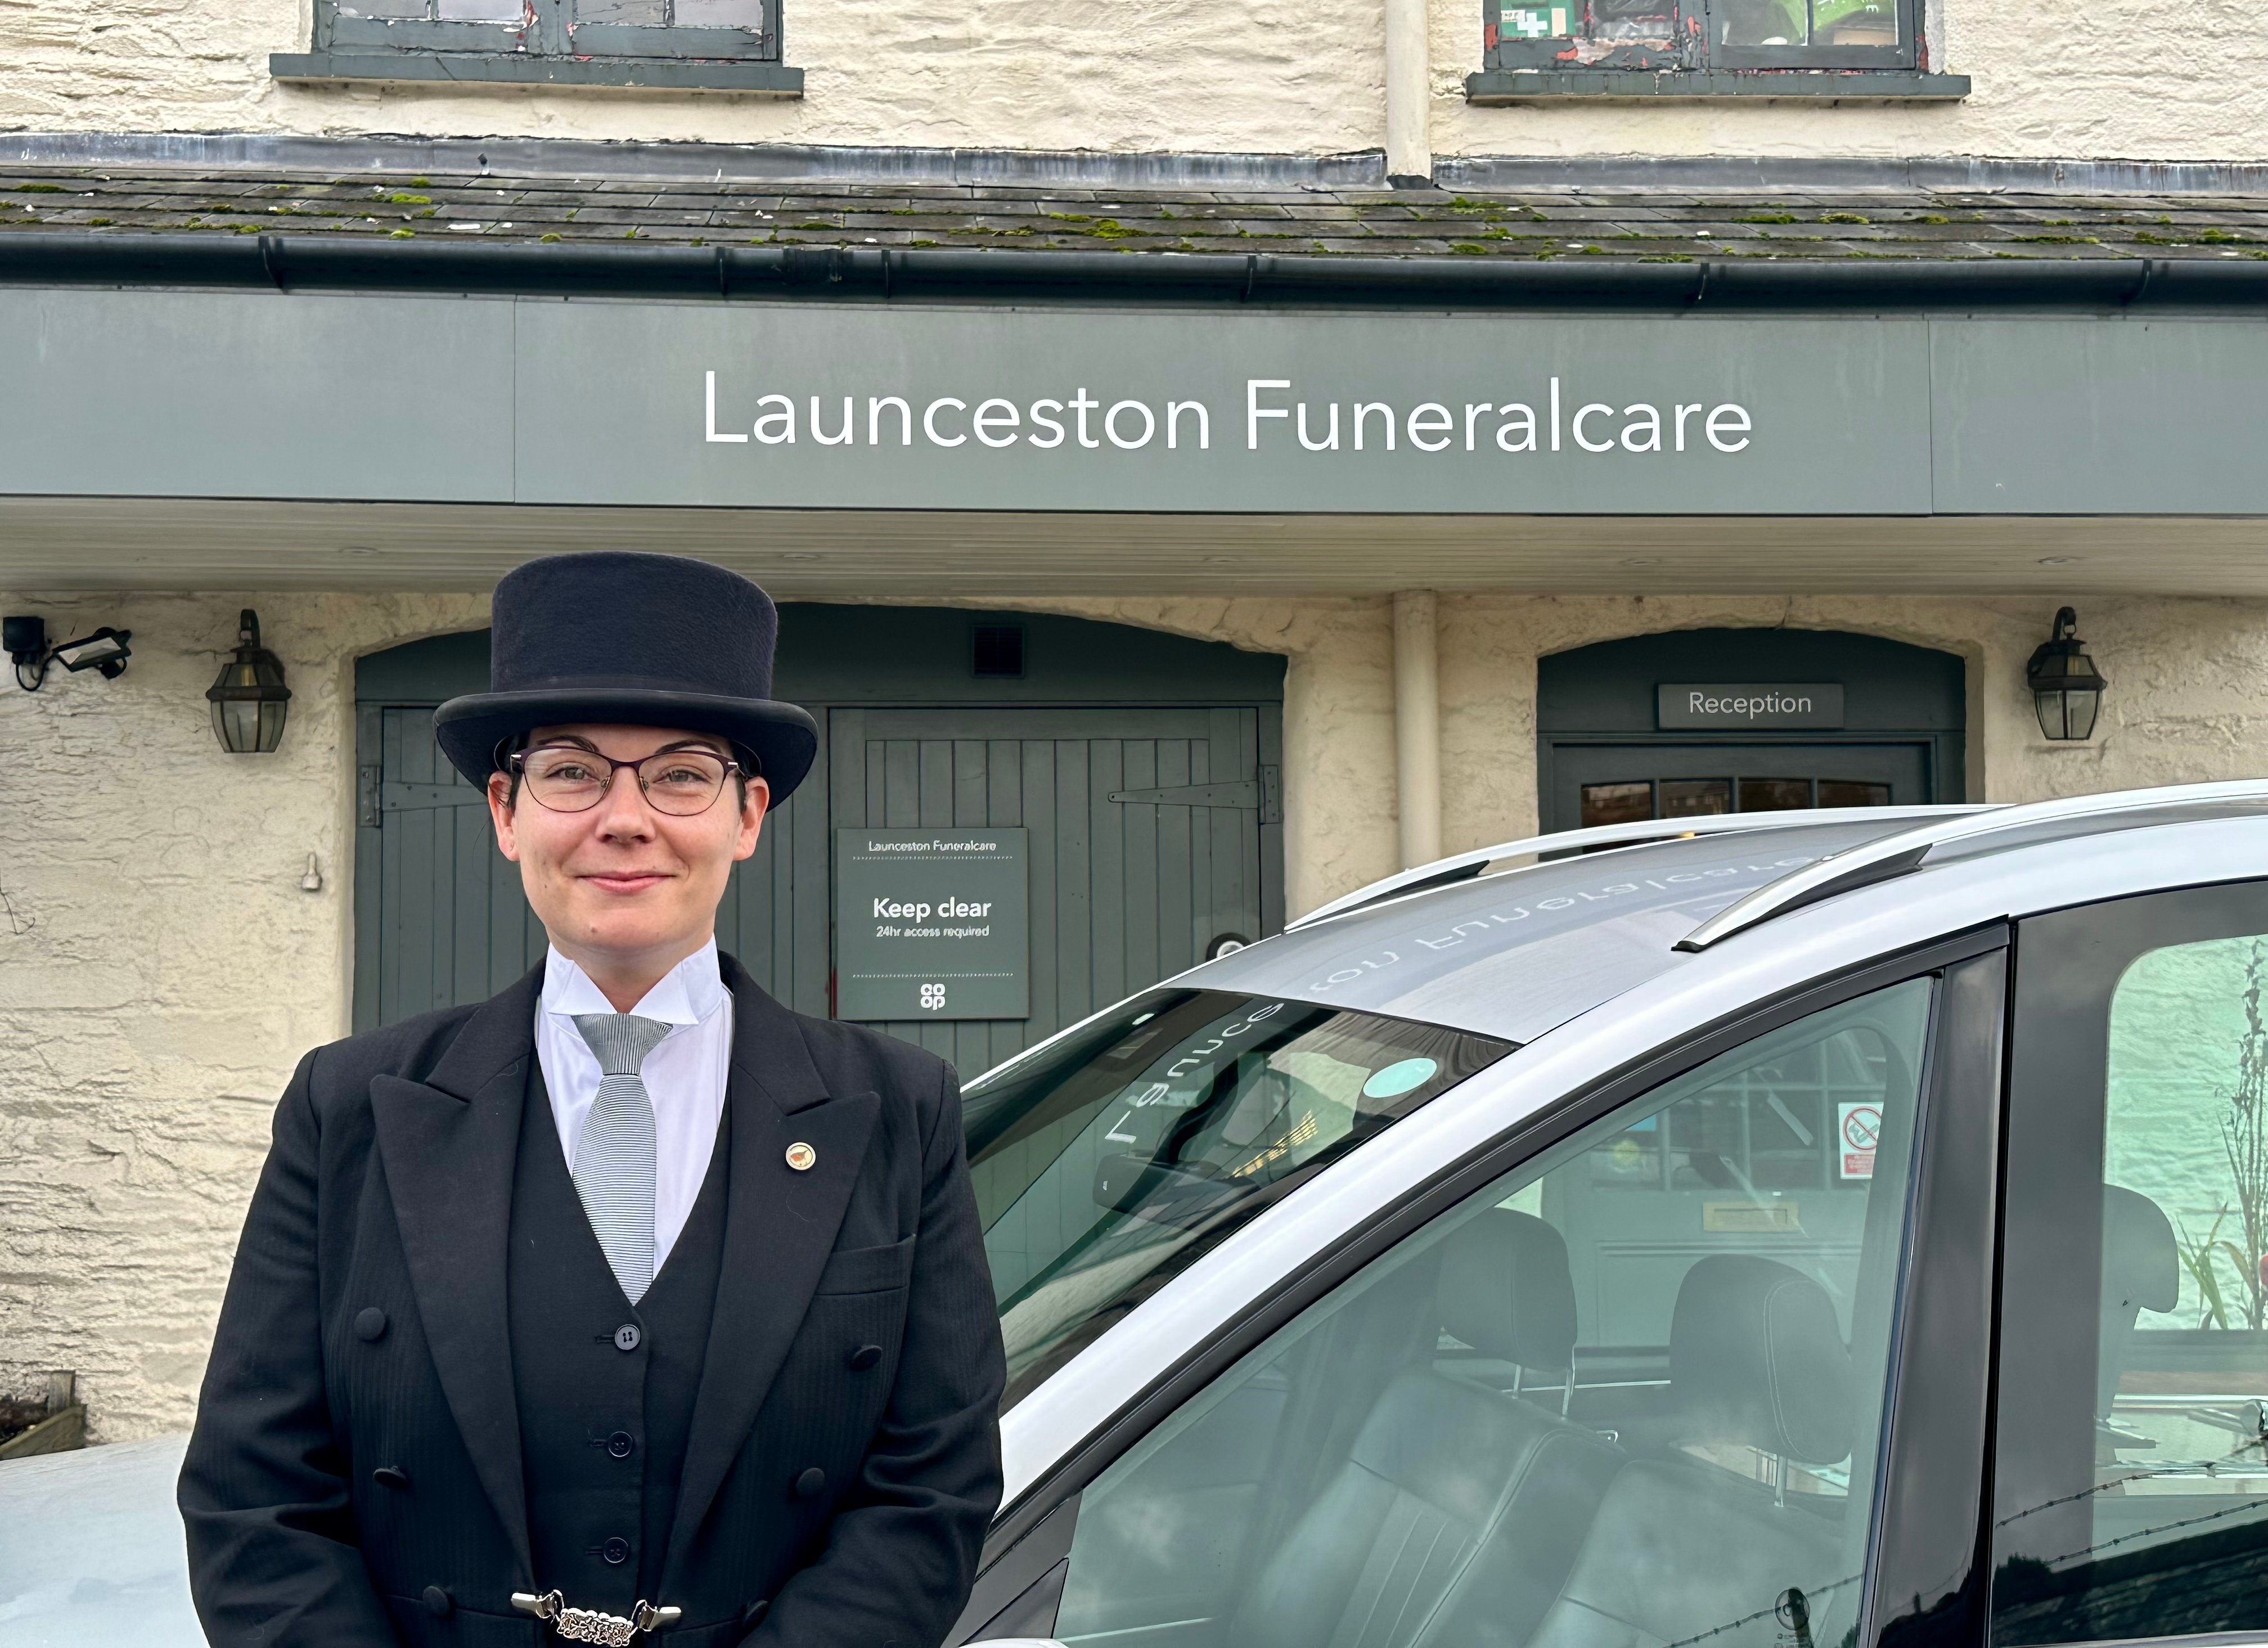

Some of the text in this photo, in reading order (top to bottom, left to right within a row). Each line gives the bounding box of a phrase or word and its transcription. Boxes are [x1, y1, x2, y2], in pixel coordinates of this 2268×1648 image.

[704, 370, 1753, 453] Launceston Funeralcare
[1689, 691, 1812, 720] Reception
[868, 840, 997, 852] Launceston Funeralcare
[873, 896, 992, 924] Keep clear
[876, 925, 990, 939] 24hr access required
